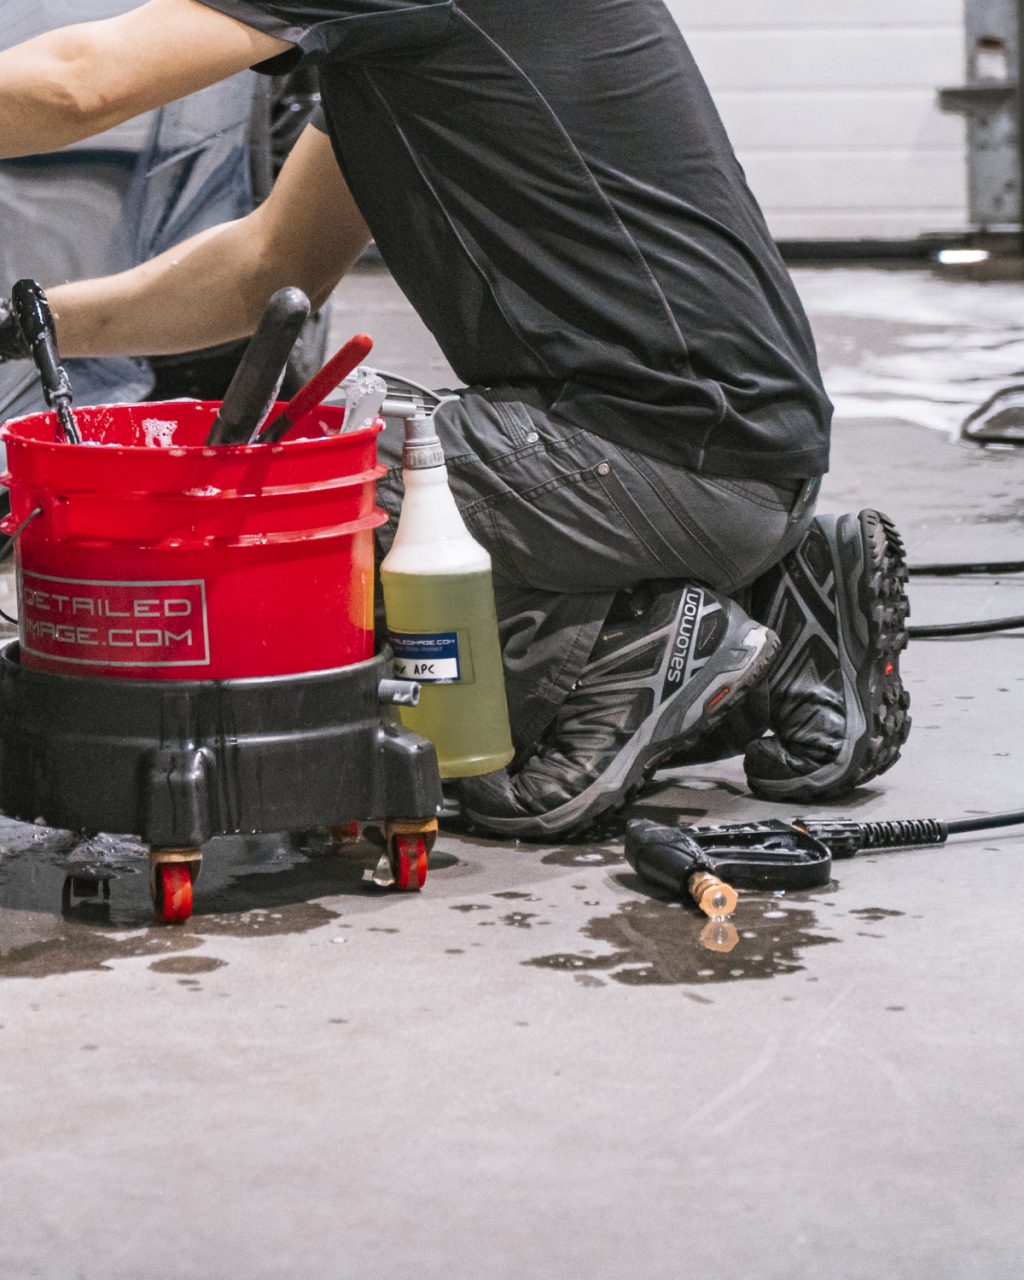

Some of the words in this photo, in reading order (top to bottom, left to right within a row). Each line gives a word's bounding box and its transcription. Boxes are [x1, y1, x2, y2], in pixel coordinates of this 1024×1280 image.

[24, 588, 192, 617] DETAILED
[26, 620, 193, 647] IMAGE.COM
[413, 664, 435, 676] APC
